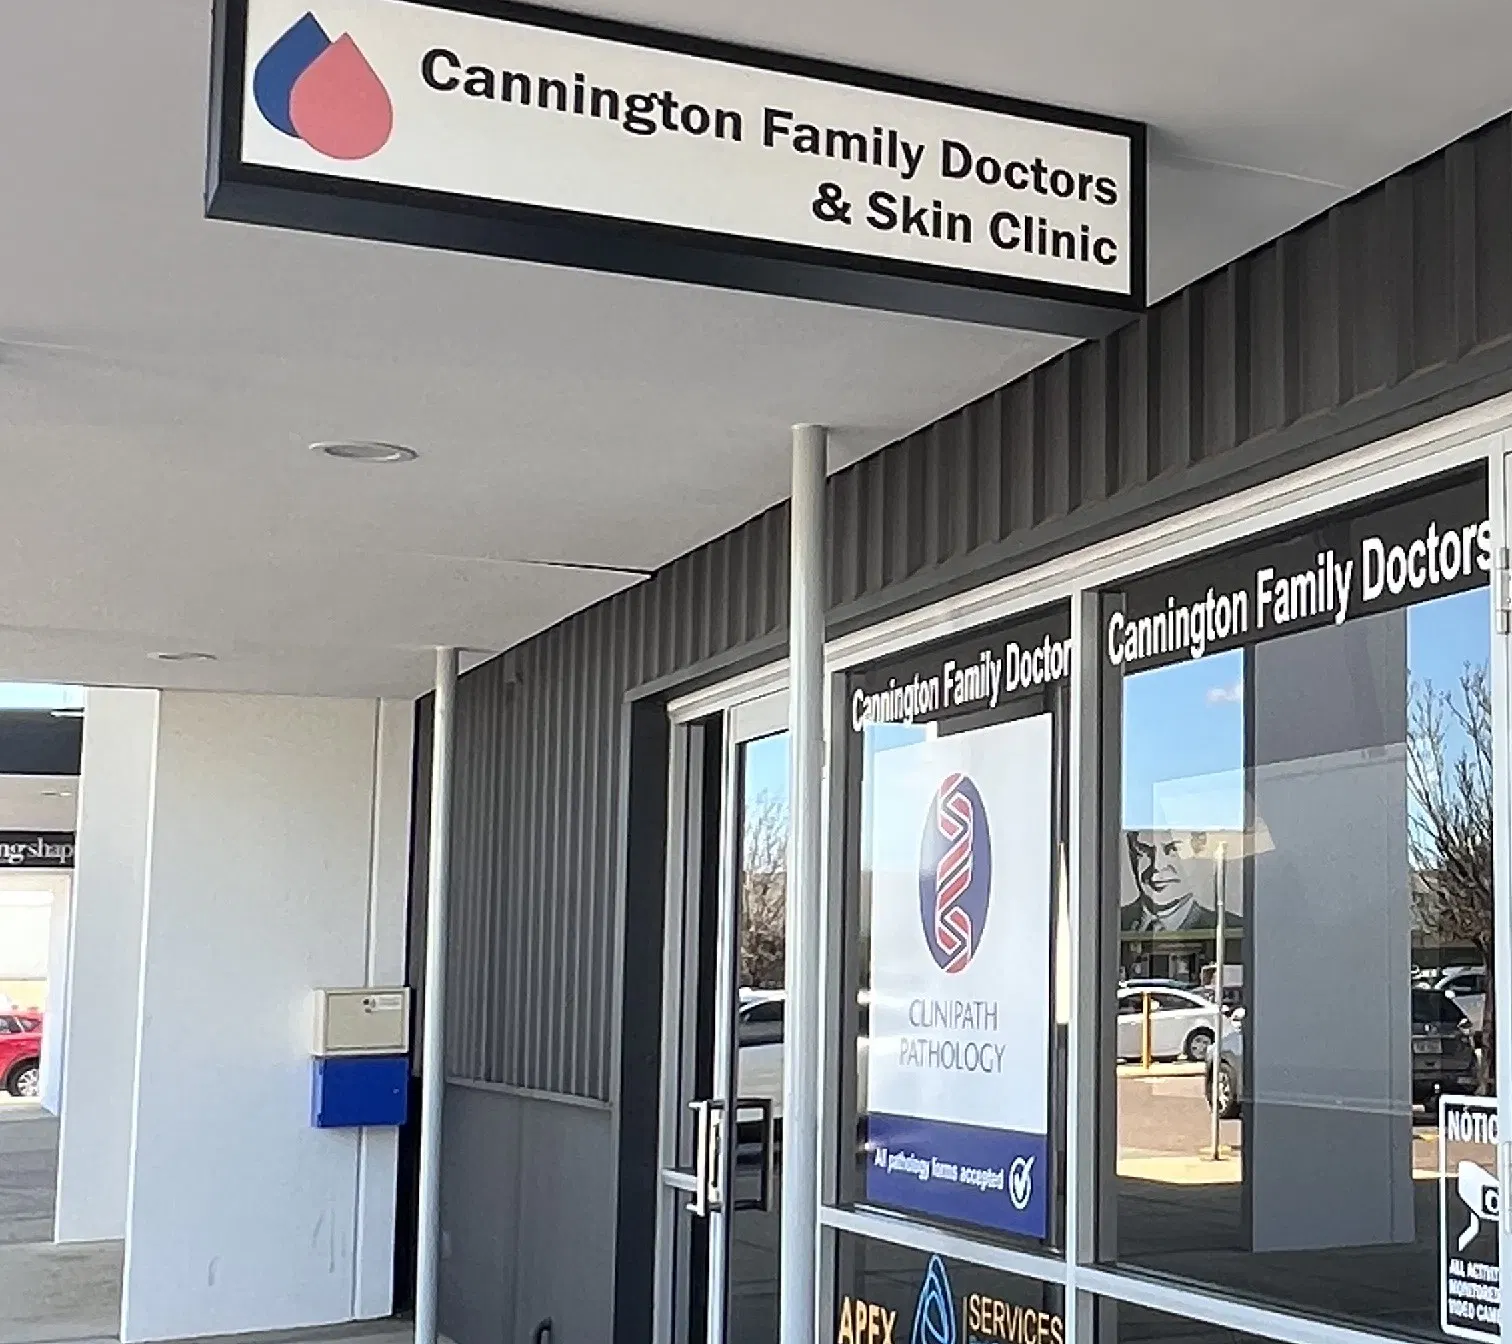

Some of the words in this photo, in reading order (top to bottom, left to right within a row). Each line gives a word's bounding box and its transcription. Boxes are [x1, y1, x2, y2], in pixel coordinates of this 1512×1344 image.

[421, 48, 743, 142] Cannington
[762, 106, 927, 180] Family
[941, 138, 1119, 205] Doctors
[812, 181, 852, 225] &
[866, 190, 972, 244] Skin
[989, 211, 1119, 266] Clinic
[1108, 595, 1248, 666] Cannington
[1256, 550, 1354, 625] Family
[1361, 518, 1493, 601] Doctors
[852, 672, 940, 732] Cannington
[942, 650, 1002, 708] Family
[899, 1038, 1007, 1074] PATHOLOGY
[908, 999, 998, 1031] CLINIPATH
